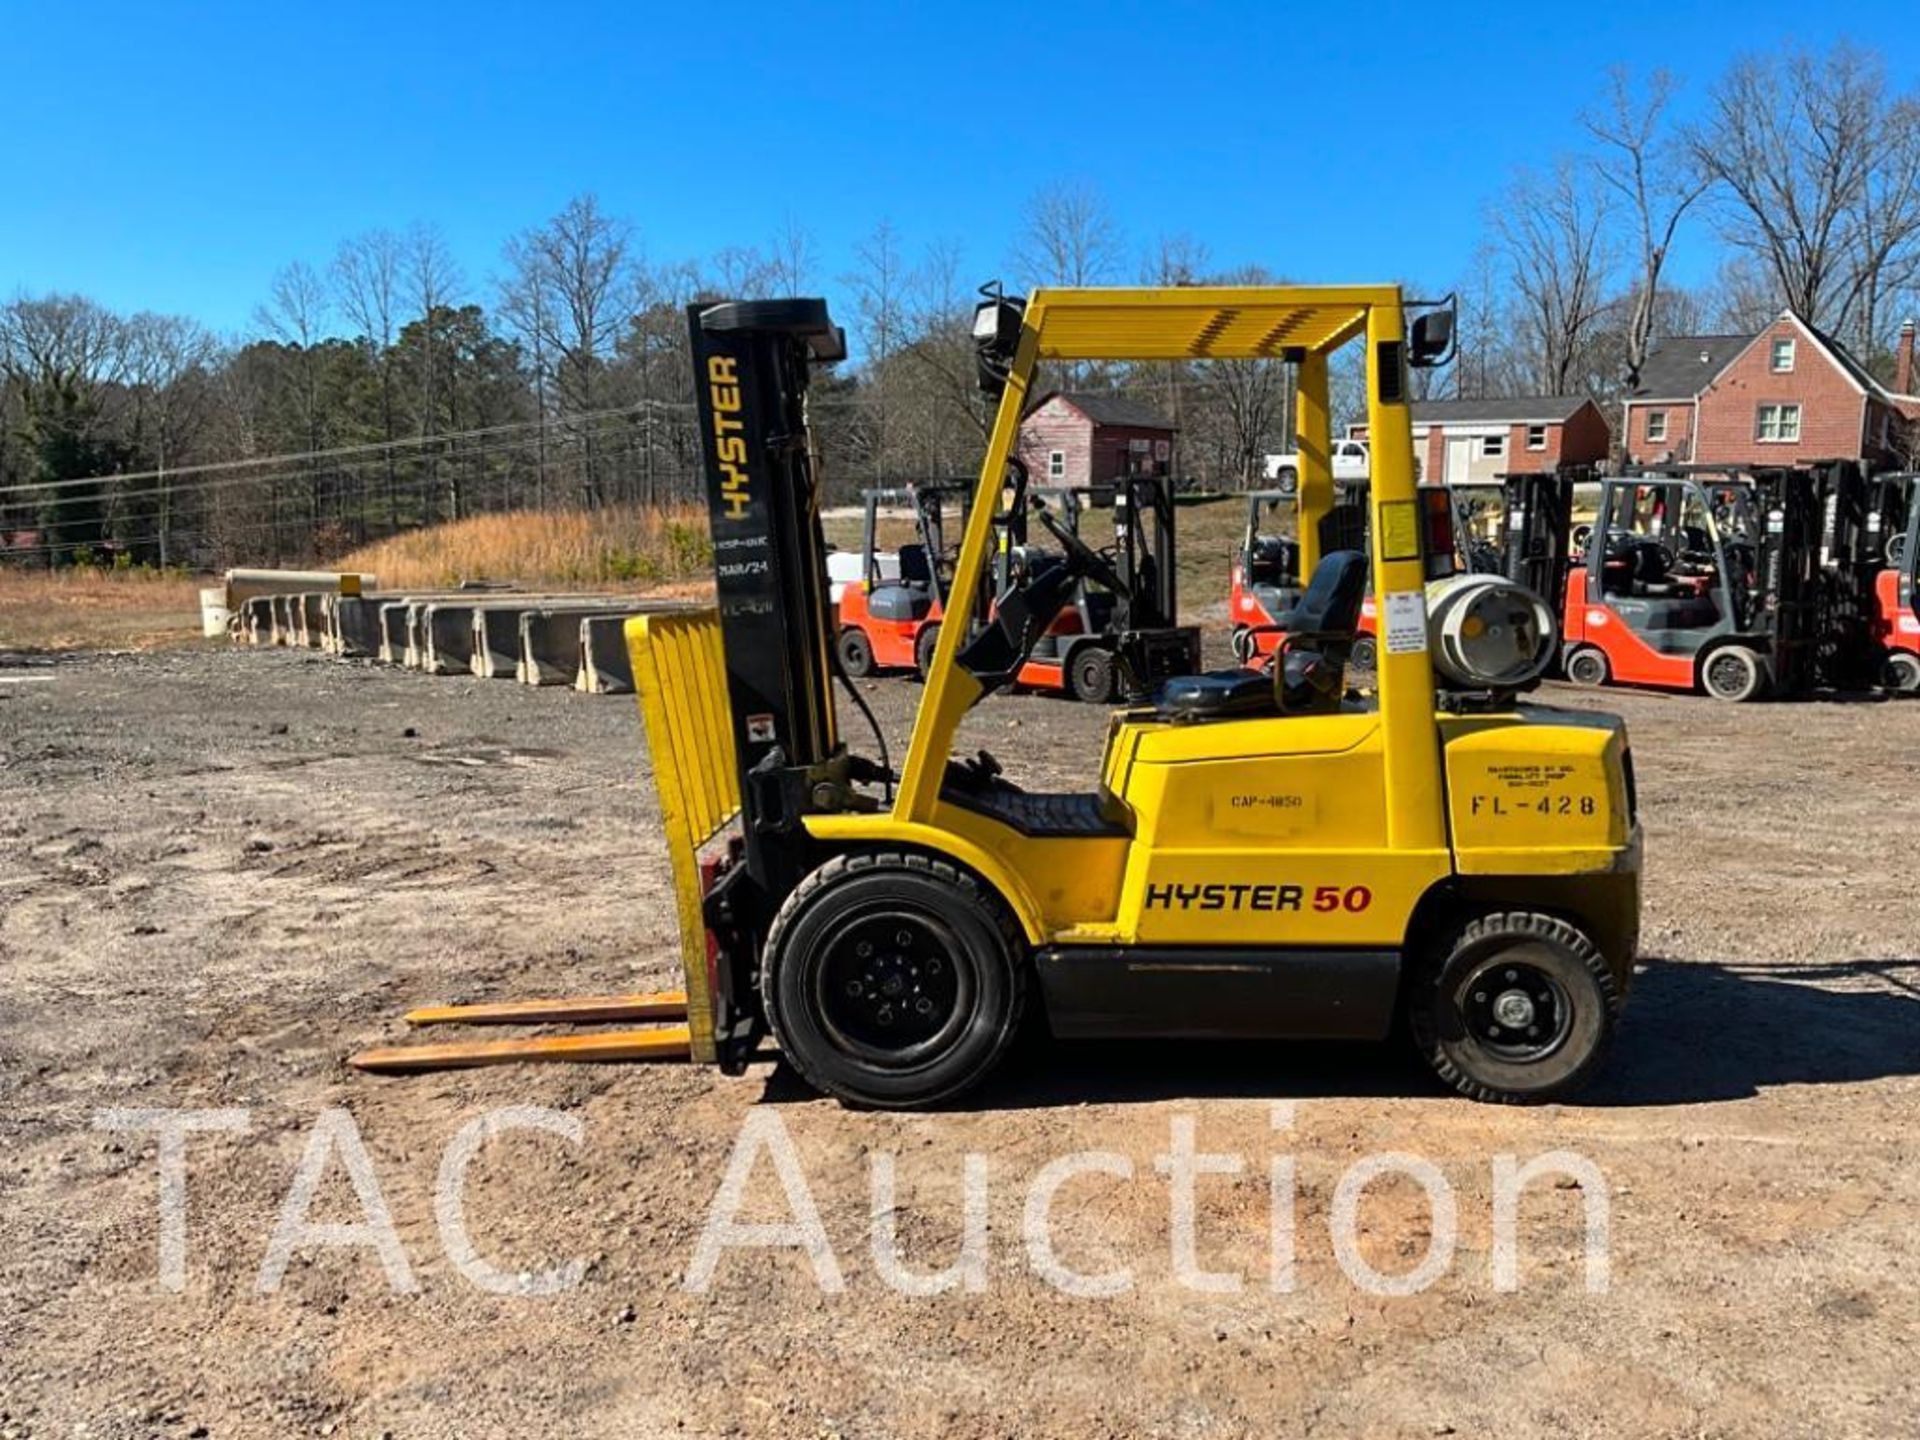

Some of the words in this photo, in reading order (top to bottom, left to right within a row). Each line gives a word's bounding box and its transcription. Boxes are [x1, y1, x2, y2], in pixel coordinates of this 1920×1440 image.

[708, 355, 750, 521] HYSTER
[1472, 796, 1594, 815] FL-428
[1145, 883, 1304, 911] HYSTER
[1313, 885, 1372, 912] 50
